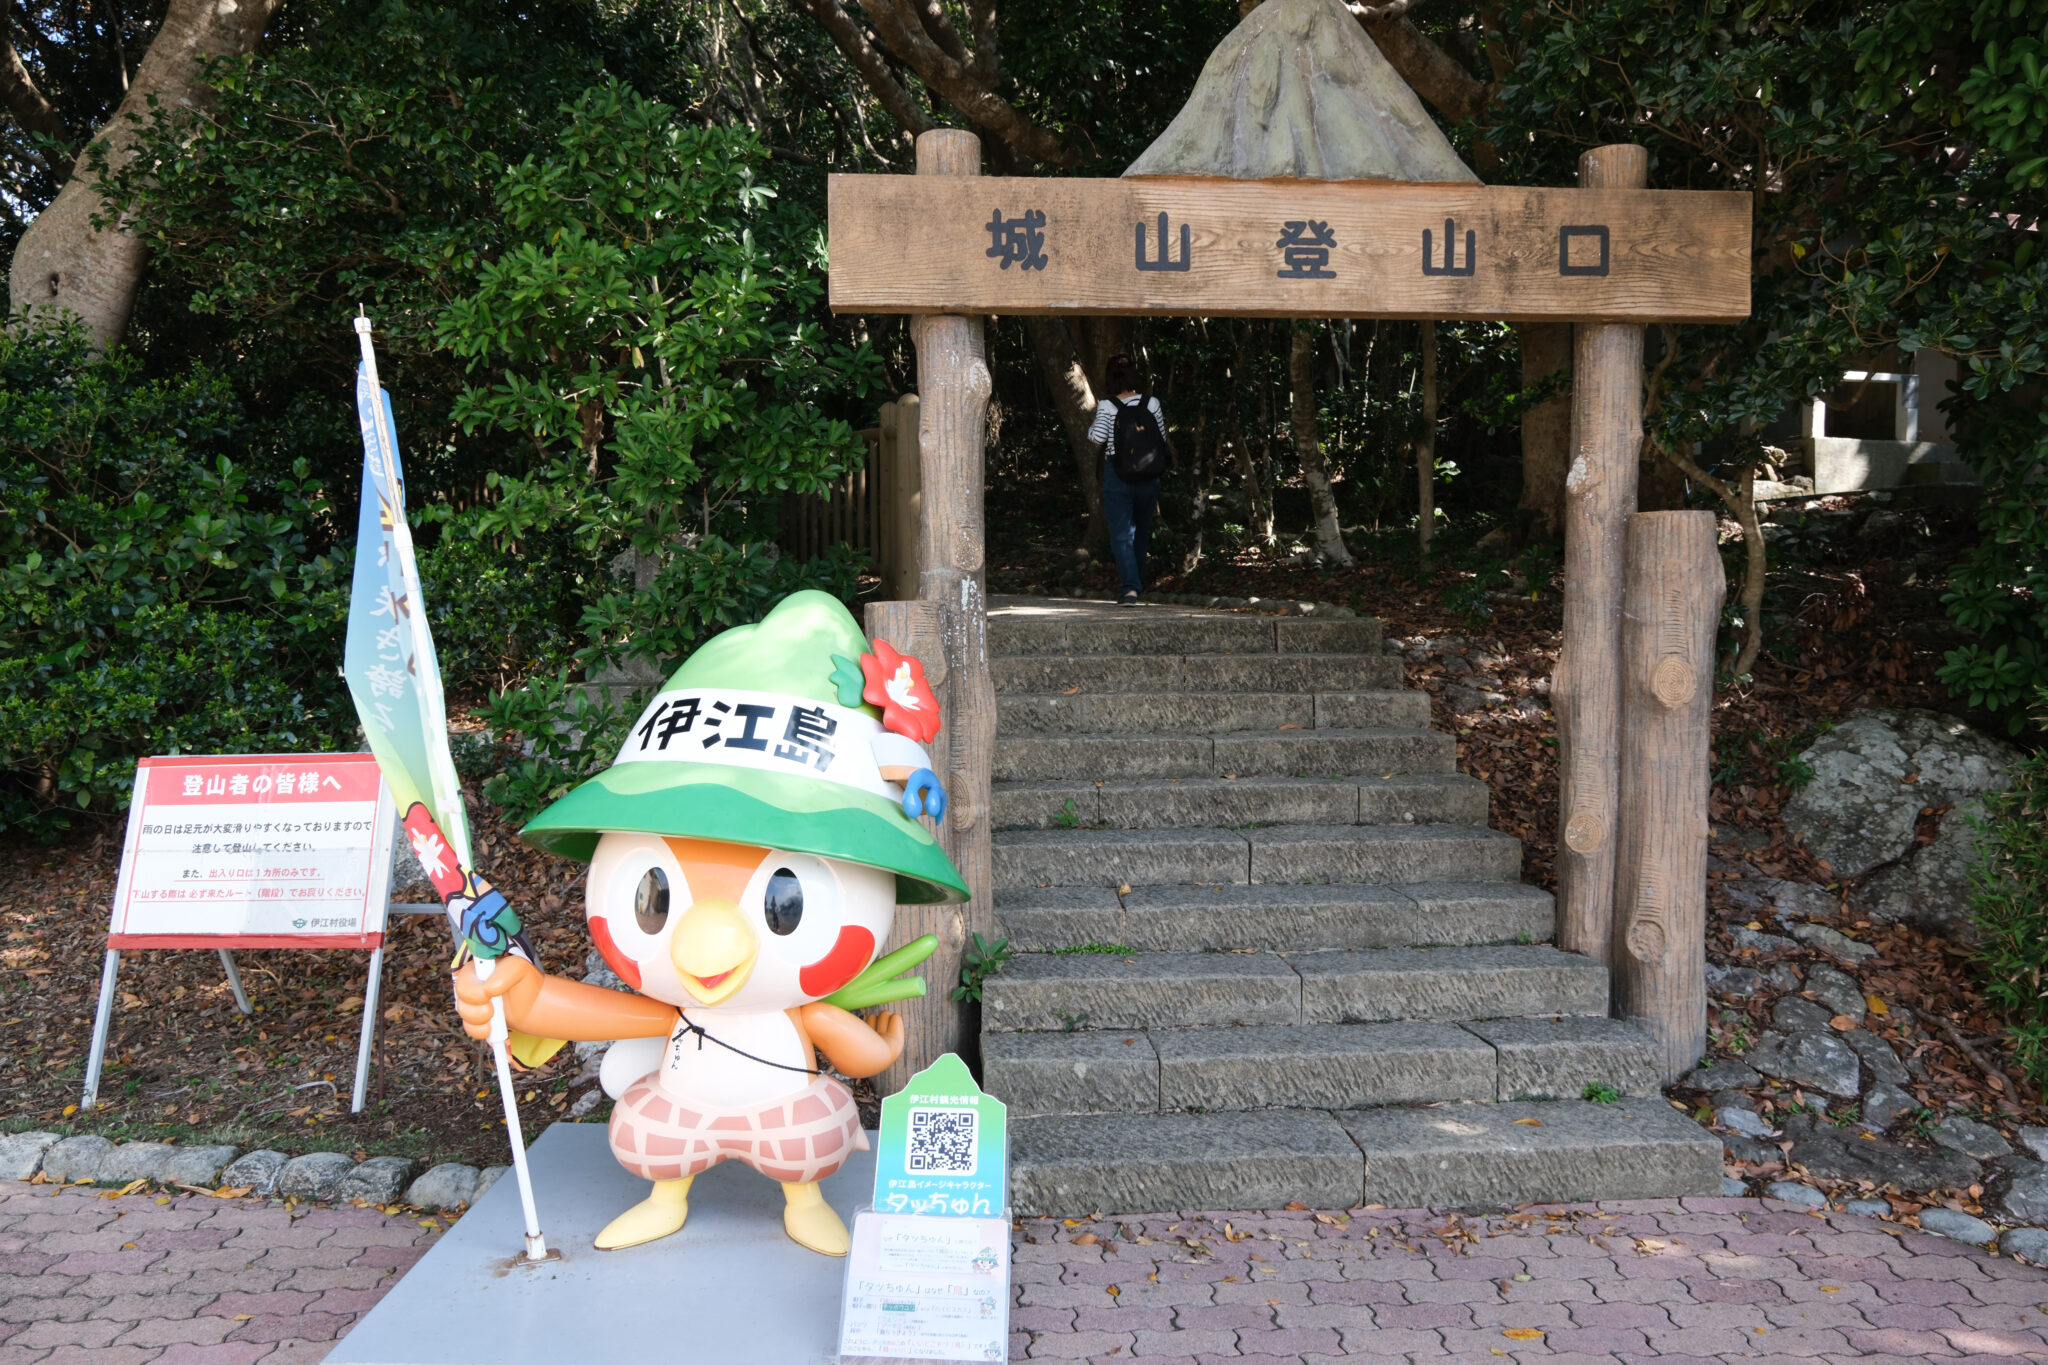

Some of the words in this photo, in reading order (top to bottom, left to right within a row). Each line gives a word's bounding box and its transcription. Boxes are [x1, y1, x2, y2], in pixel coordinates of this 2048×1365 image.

[985, 207, 1611, 279] 城山登山口
[637, 697, 838, 773] 伊江島
[182, 772, 342, 796] 登山者の皆様へ
[311, 917, 356, 929] 伊江村役場
[910, 1094, 979, 1105] 伊江村観光情報
[888, 1179, 992, 1189] 伊江島イメージキャラクター
[886, 1191, 991, 1215] タッちゅん
